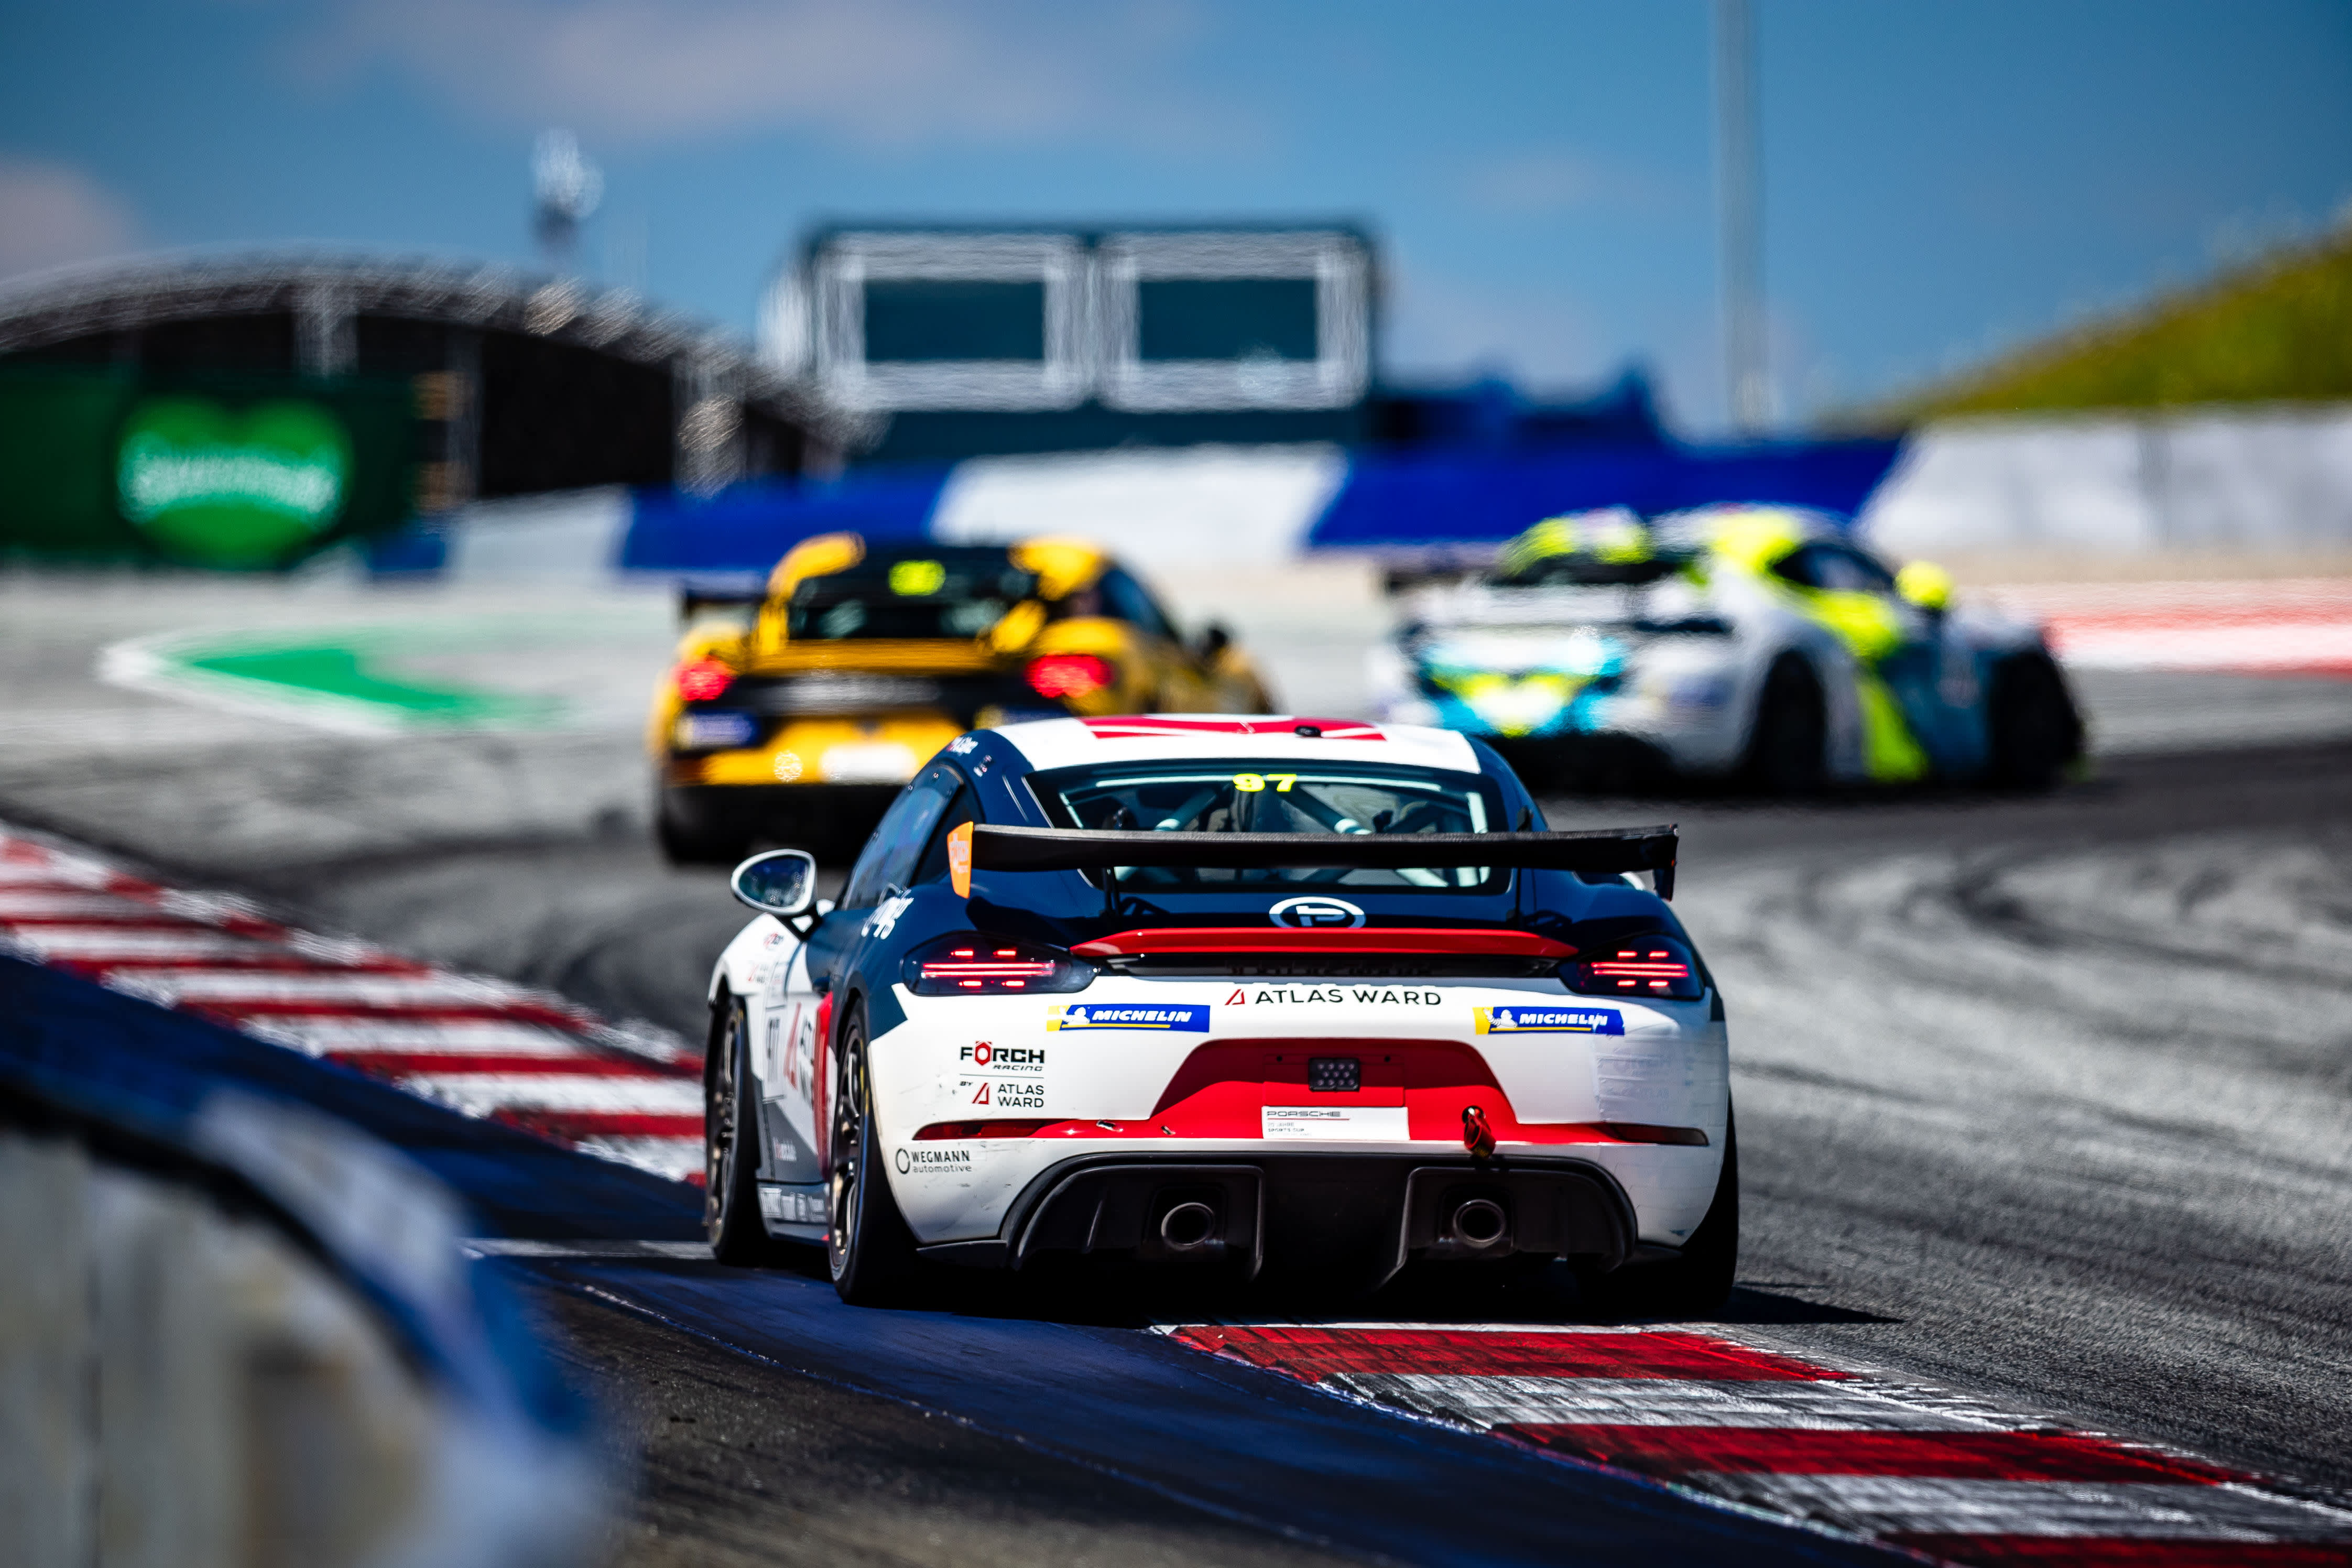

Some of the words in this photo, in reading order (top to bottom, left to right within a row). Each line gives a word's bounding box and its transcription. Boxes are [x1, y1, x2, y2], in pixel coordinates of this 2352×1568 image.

[1233, 773, 1297, 792] 97
[1255, 989, 1343, 1004] ATLAS
[1353, 989, 1441, 1005] WARD
[1092, 1010, 1193, 1022] MICHELIN
[1520, 1013, 1608, 1026] MICHELIN
[998, 1084, 1044, 1095] ATLAS
[998, 1096, 1044, 1108] WARD
[911, 1150, 971, 1162] WEGMANN
[913, 1164, 972, 1173] automotive
